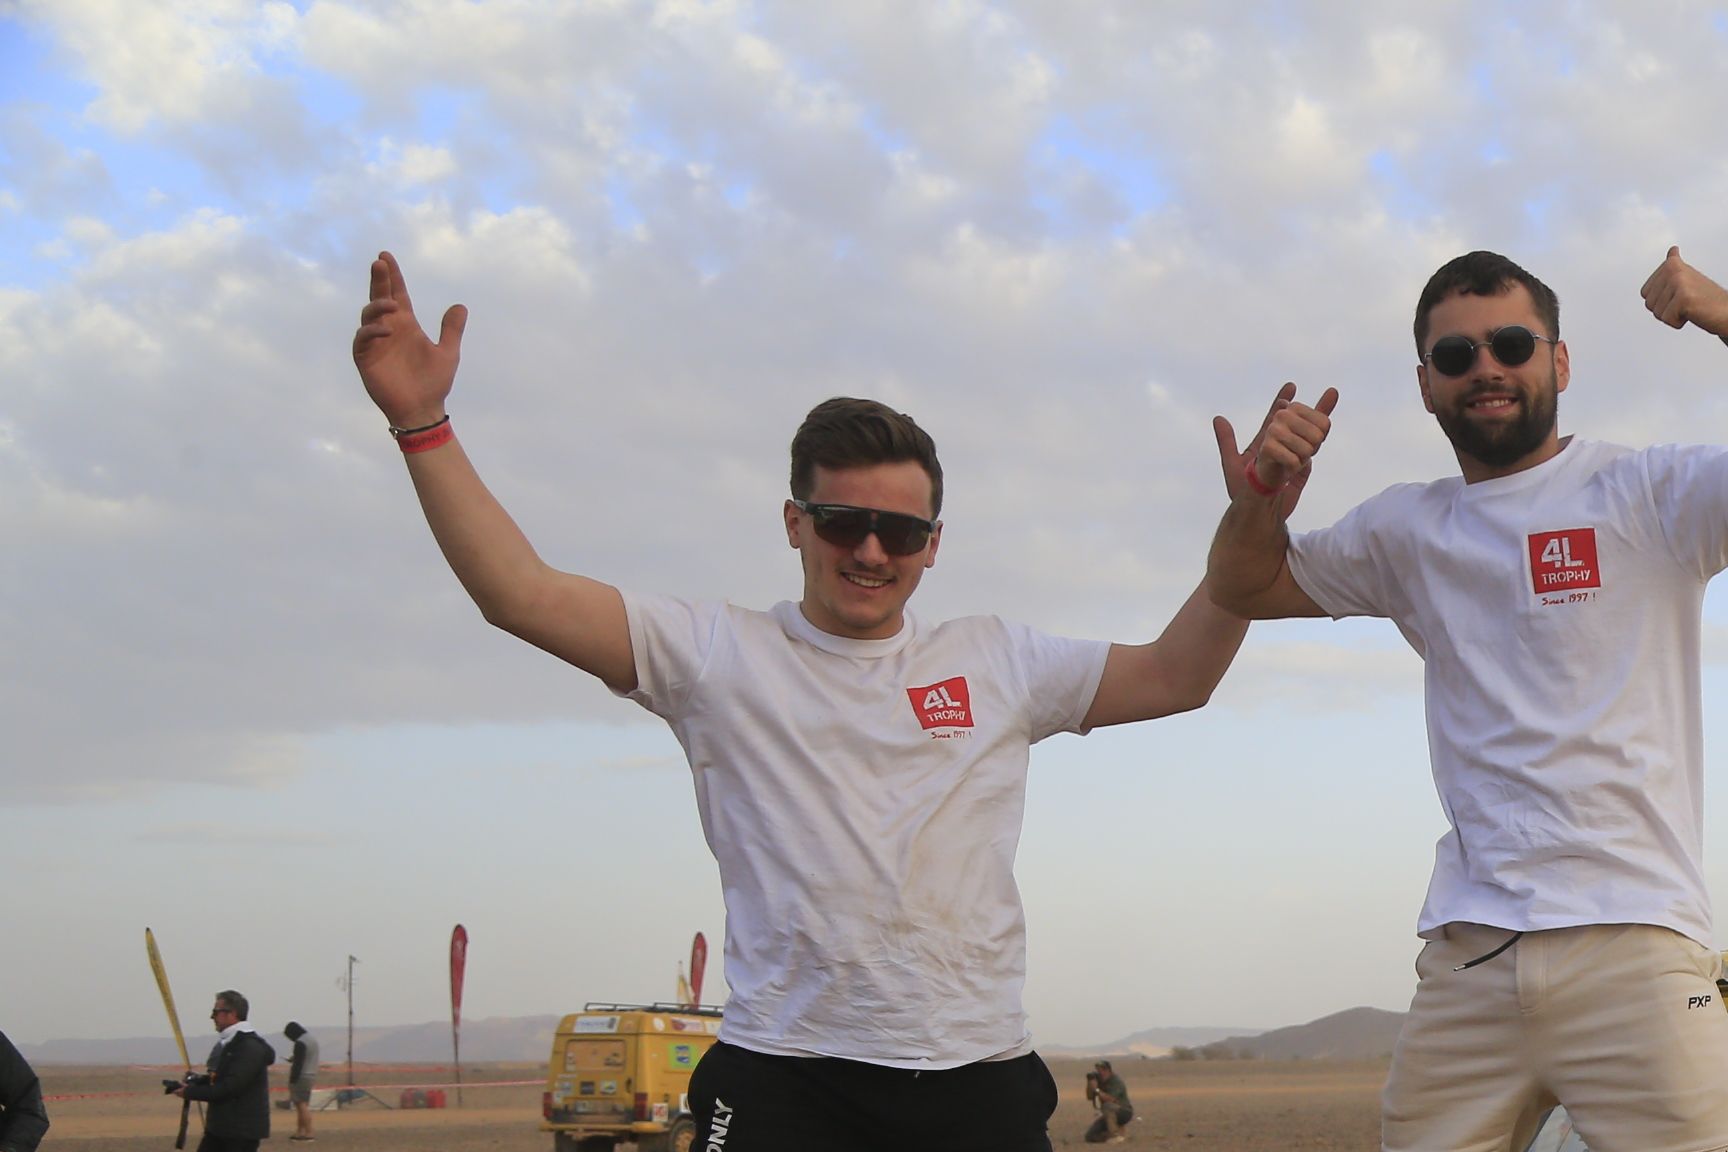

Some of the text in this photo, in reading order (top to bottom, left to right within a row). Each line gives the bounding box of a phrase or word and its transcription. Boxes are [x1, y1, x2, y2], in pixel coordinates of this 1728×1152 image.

[1541, 537, 1585, 568] 4L
[1541, 570, 1591, 585] TROPHY
[1542, 597, 1565, 606] Since
[1569, 593, 1588, 603] 1997
[923, 686, 962, 710] 4L
[1687, 995, 1712, 1009] PXP
